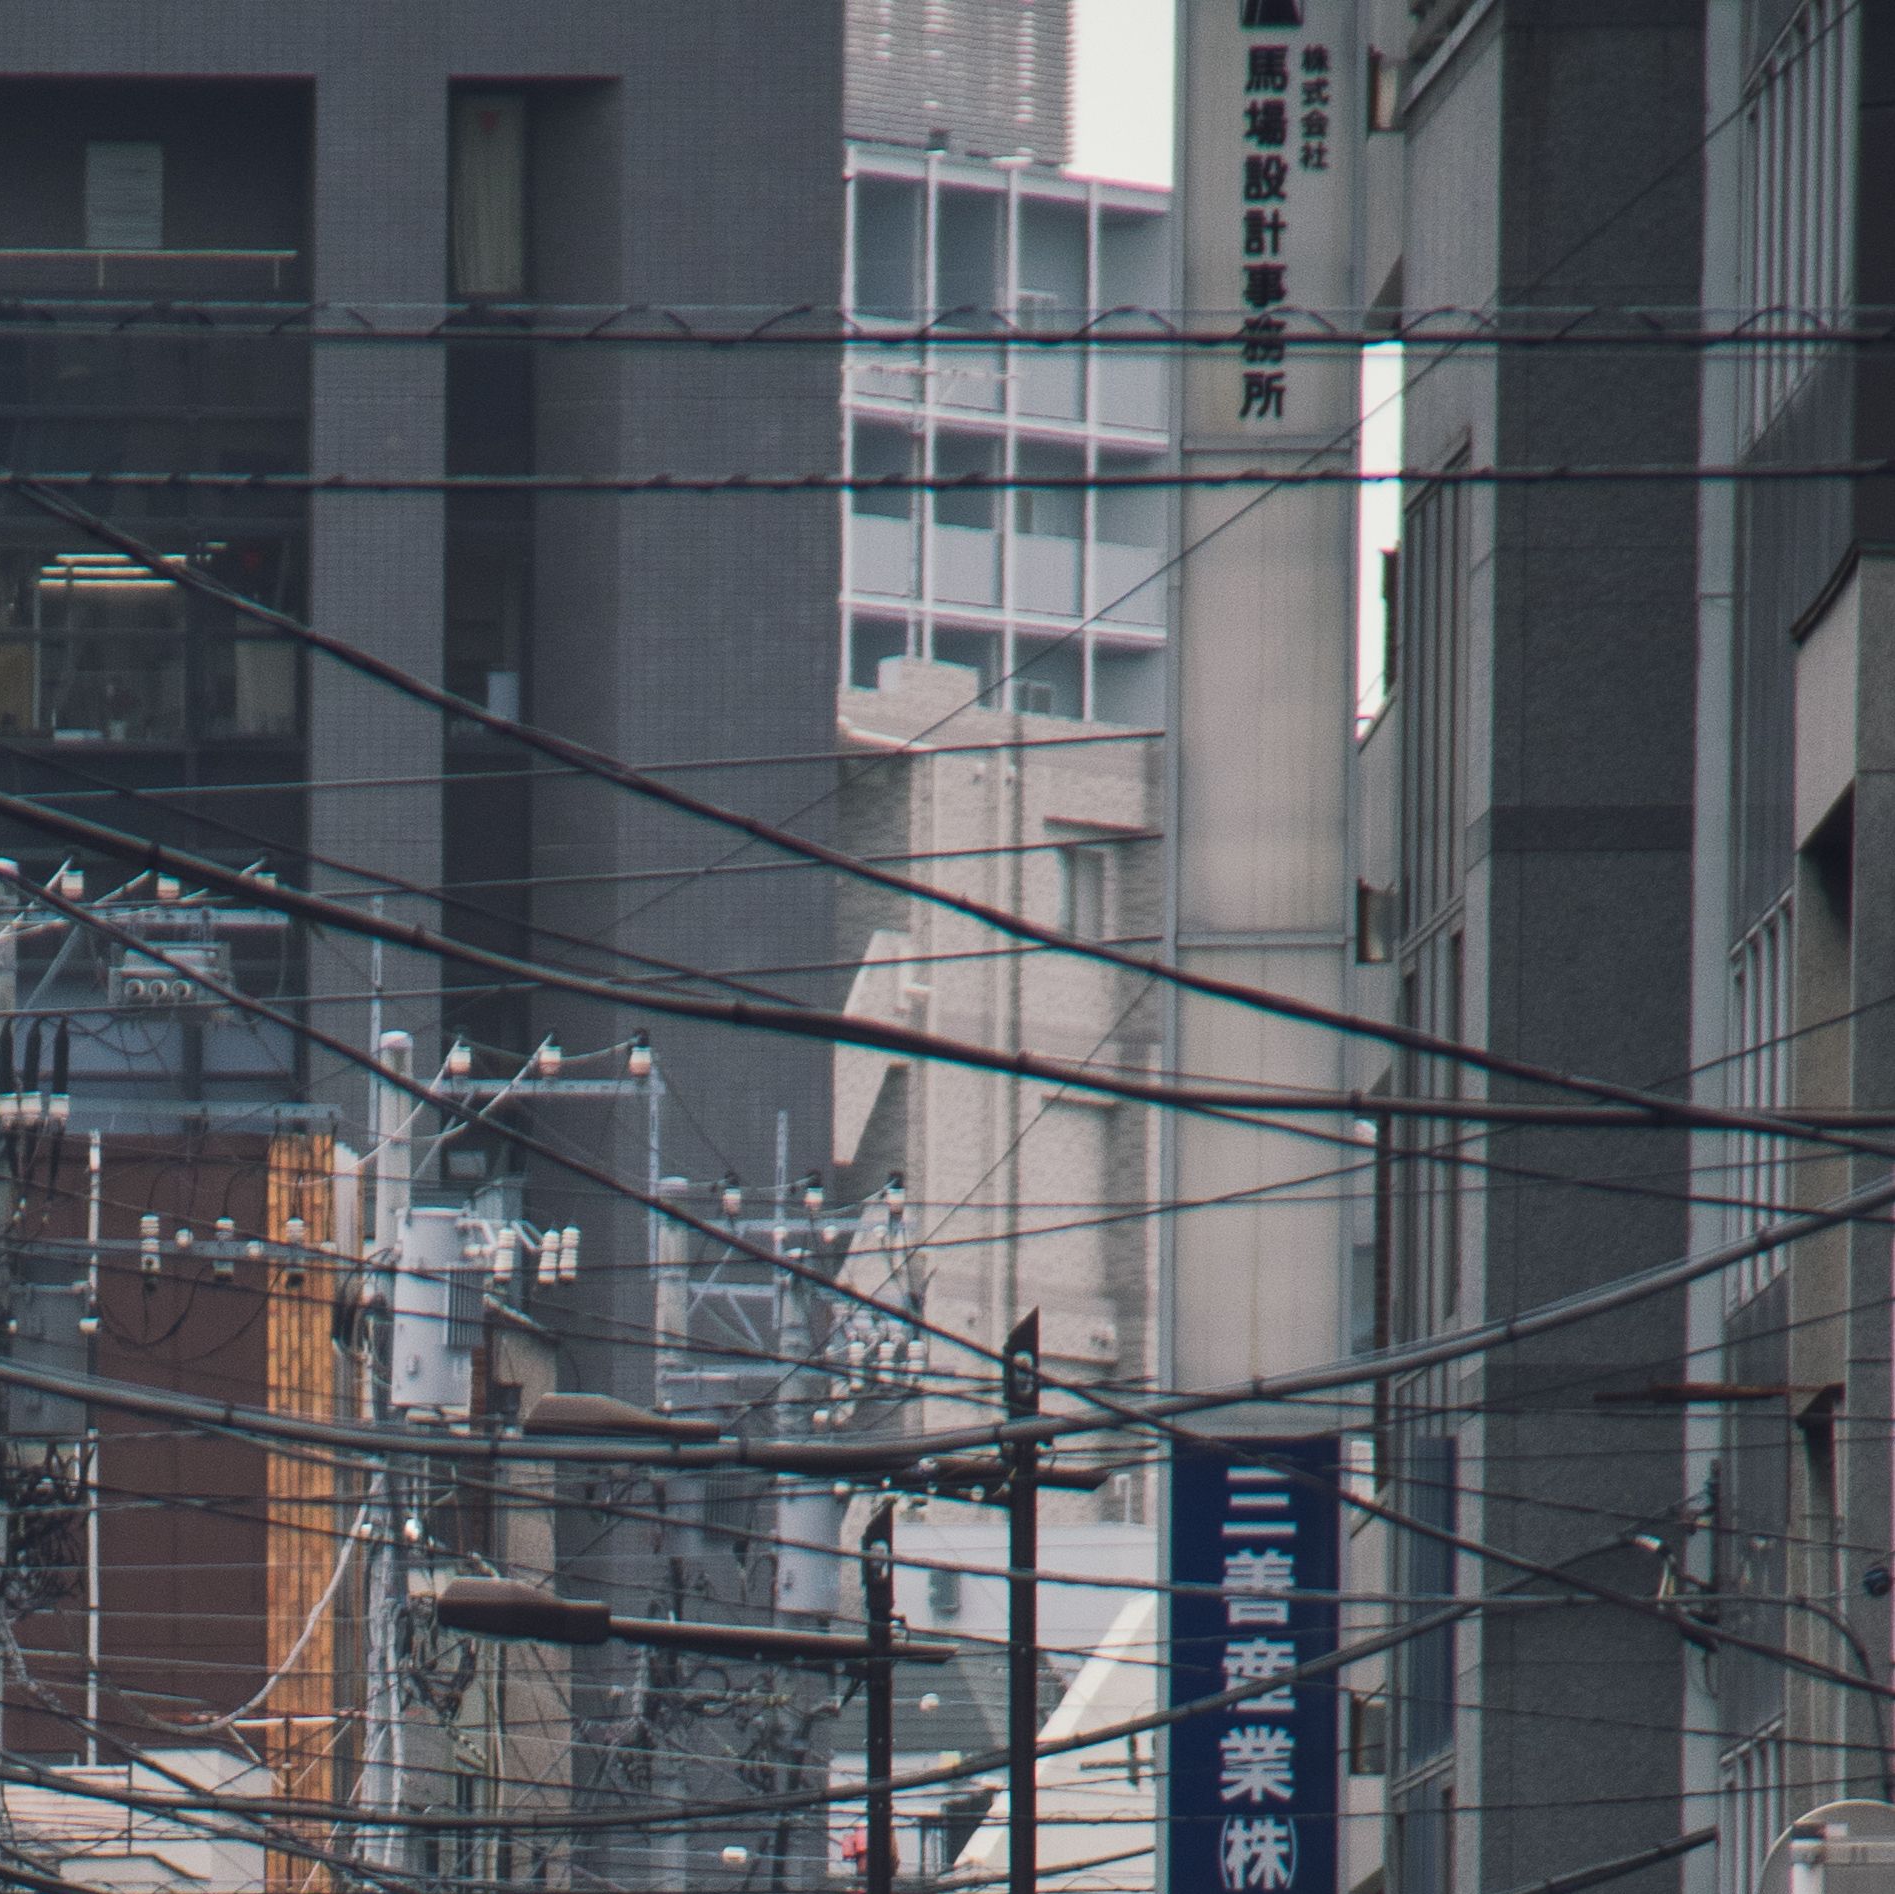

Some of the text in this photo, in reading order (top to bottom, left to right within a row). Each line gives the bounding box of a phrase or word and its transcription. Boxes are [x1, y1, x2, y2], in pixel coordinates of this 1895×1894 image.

[1239, 44, 1290, 420] 馬場設計事務所
[1300, 43, 1329, 171] 株式会社
